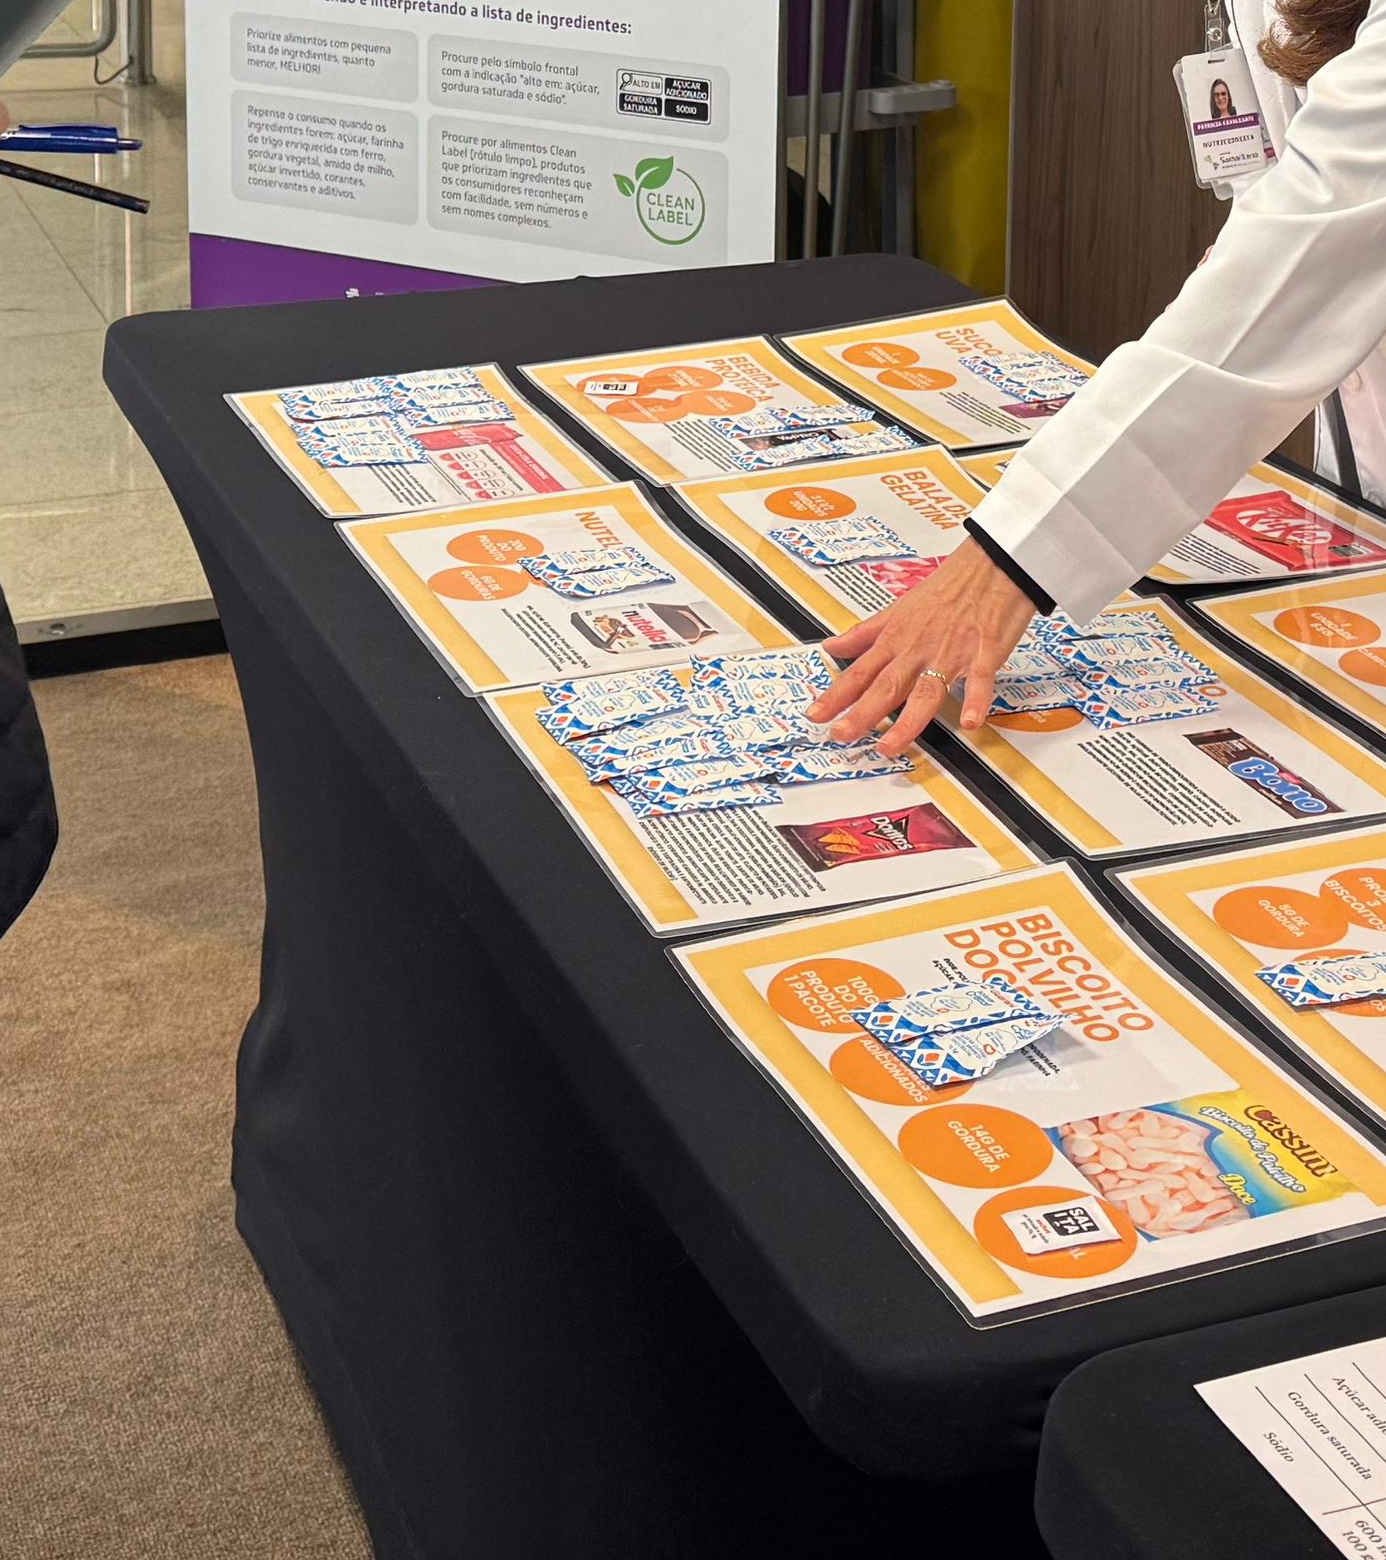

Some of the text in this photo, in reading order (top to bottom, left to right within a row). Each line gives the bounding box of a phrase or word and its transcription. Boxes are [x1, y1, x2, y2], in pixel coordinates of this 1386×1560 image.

[470, 6, 478, 18] a
[482, 4, 512, 21] lista
[516, 8, 533, 24] de
[537, 10, 632, 35] ingredientes:
[646, 192, 695, 211] CLEAN
[647, 207, 693, 226] LABEL
[935, 330, 971, 354] UVA
[955, 327, 1002, 357] SUCO
[727, 356, 781, 390] BEBIDA
[880, 475, 958, 530] GELATINA
[903, 470, 949, 504] BALA
[622, 609, 669, 645] nutella
[870, 816, 912, 851] Doritos
[1256, 898, 1305, 938] GORDURA
[1292, 913, 1310, 928] DE
[1365, 898, 1379, 909] 3
[944, 929, 1035, 1000] DOC
[1016, 913, 1154, 1032] BISCOITO
[799, 969, 854, 1025] PRODUTO
[832, 985, 857, 1003] DO
[847, 975, 880, 1006] 100G
[981, 921, 1119, 1043] POLVILHO
[788, 980, 835, 1028] PACOTE
[861, 1038, 926, 1104] ADICIONADOS
[946, 1119, 1000, 1173] GORDURA
[970, 1124, 1011, 1160] 14G DE
[1201, 1106, 1256, 1143] Biscoito
[1259, 1150, 1307, 1193] Polvilho
[1217, 1172, 1258, 1206] Doce
[1052, 1210, 1079, 1235] ITA
[1067, 1206, 1098, 1233] SAL
[1332, 1376, 1375, 1420] Açúcar
[1263, 1430, 1294, 1464] Sódio
[1288, 1390, 1373, 1481] Gordura saturada
